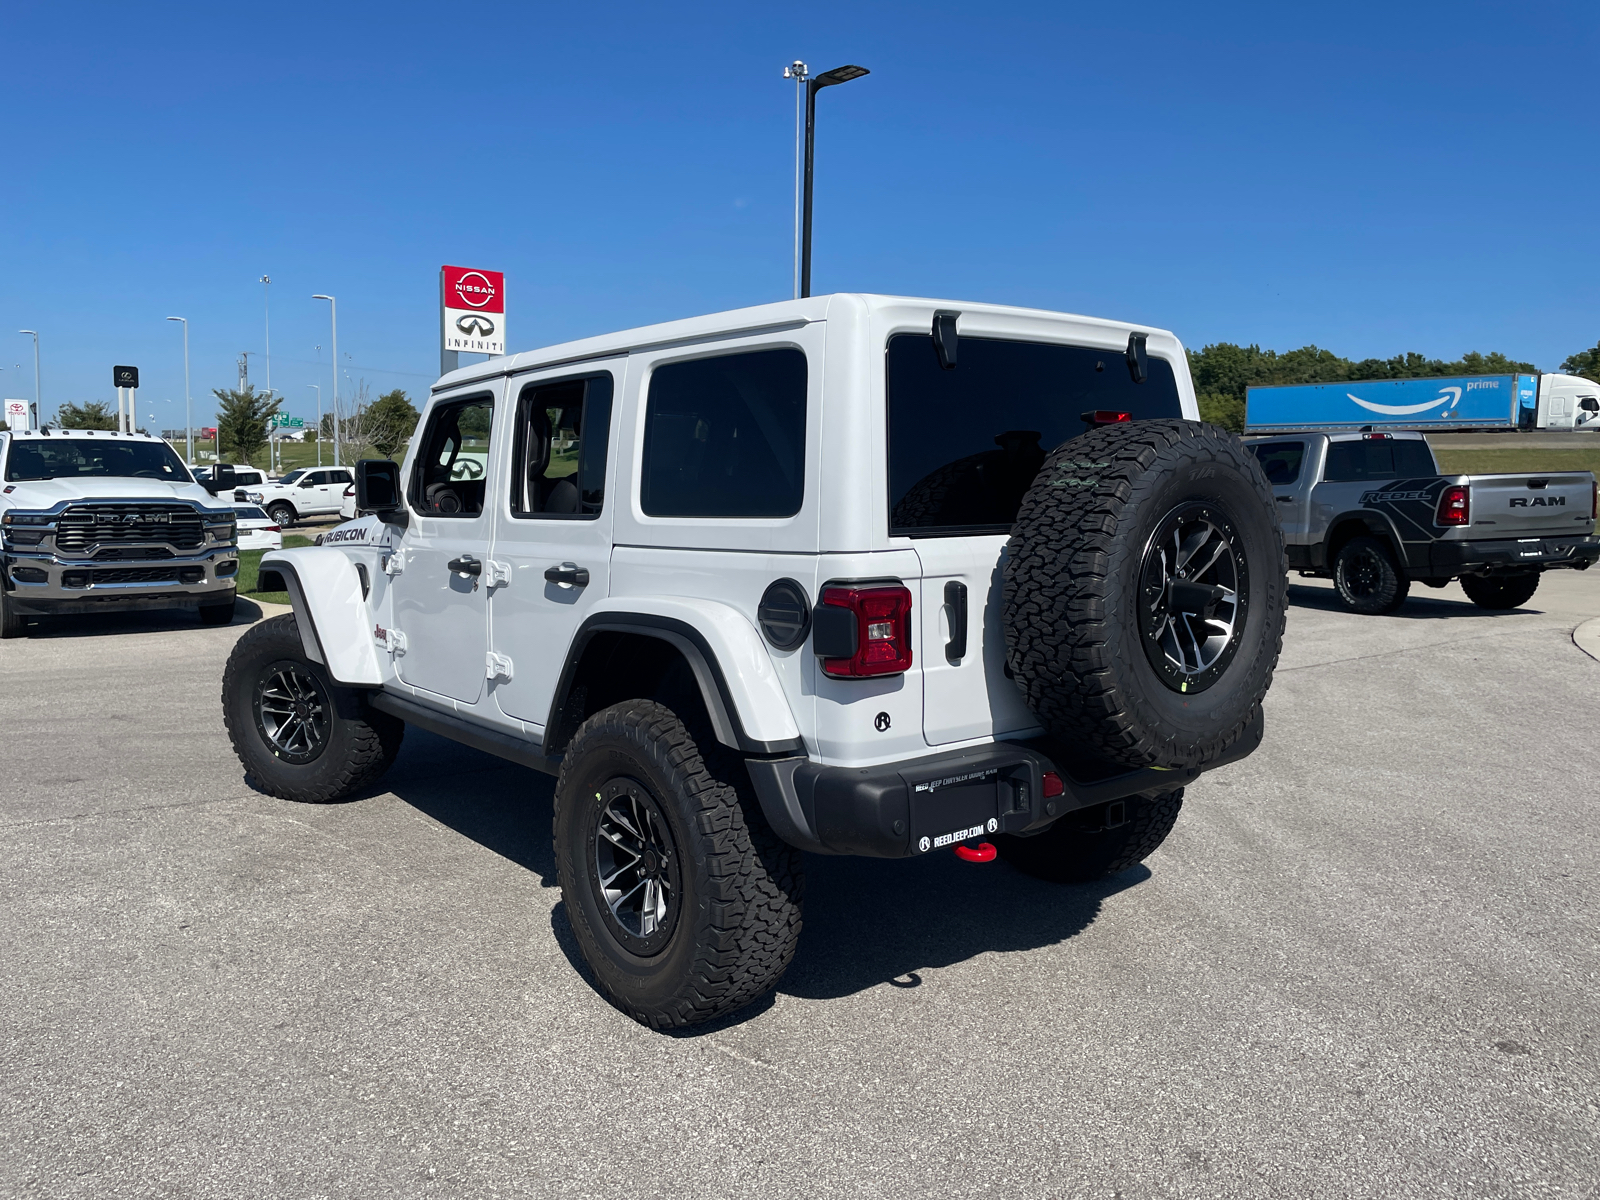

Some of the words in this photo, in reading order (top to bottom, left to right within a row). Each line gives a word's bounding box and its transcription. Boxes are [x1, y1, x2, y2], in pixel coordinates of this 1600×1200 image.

[455, 283, 495, 295] NISSAN
[448, 338, 503, 351] INFINITI
[1467, 379, 1499, 391] prime
[1358, 490, 1432, 504] REBEL
[1509, 496, 1566, 508] RAM
[97, 513, 168, 523] RAM
[324, 528, 367, 543] RUBICON
[915, 782, 929, 792] REED
[930, 779, 942, 789] JEEP
[933, 825, 985, 848] REEDJEEP.COM
